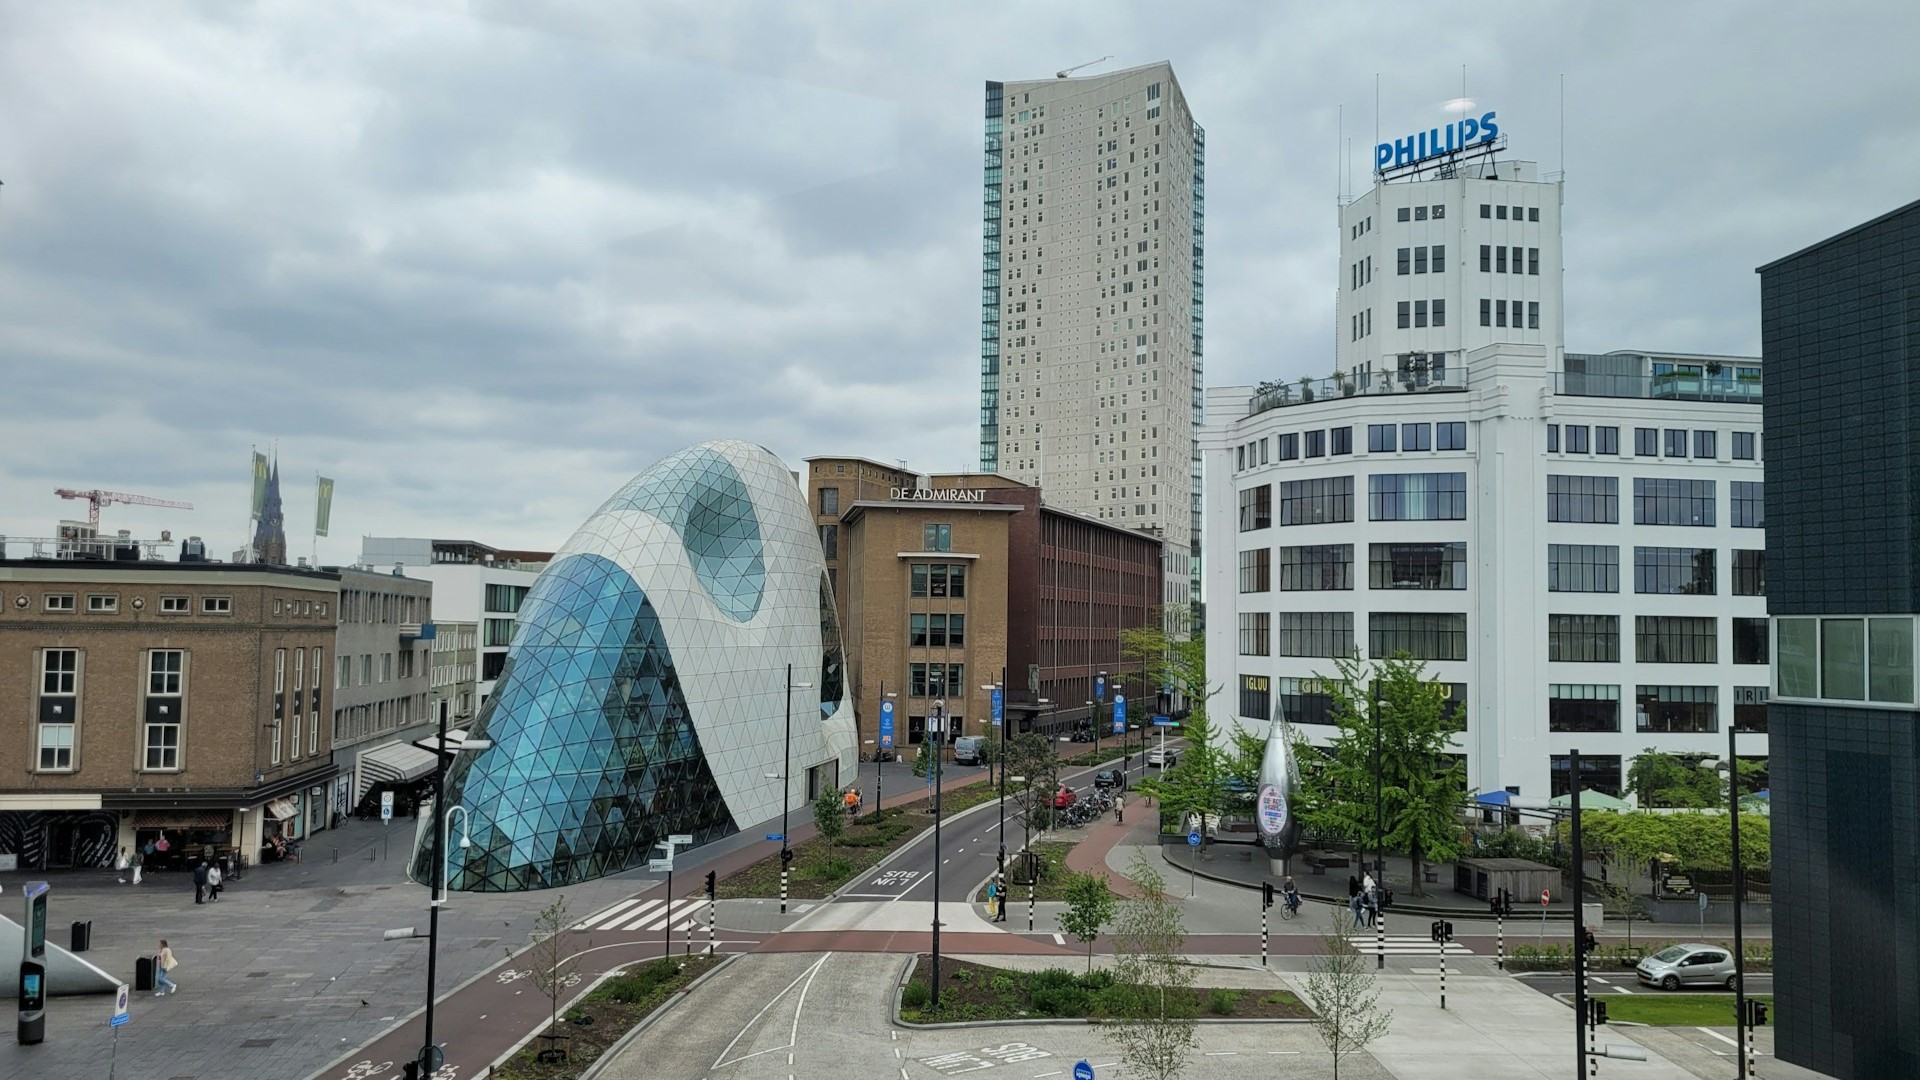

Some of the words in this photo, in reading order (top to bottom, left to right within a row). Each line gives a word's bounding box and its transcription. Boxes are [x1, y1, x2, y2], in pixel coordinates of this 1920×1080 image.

[1375, 111, 1498, 169] PHILIPS
[890, 487, 909, 500] DE
[912, 488, 986, 502] ADMIRANT
[1246, 676, 1268, 692] IGLUU
[883, 870, 919, 879] BUS
[981, 1042, 1053, 1064] BUS
